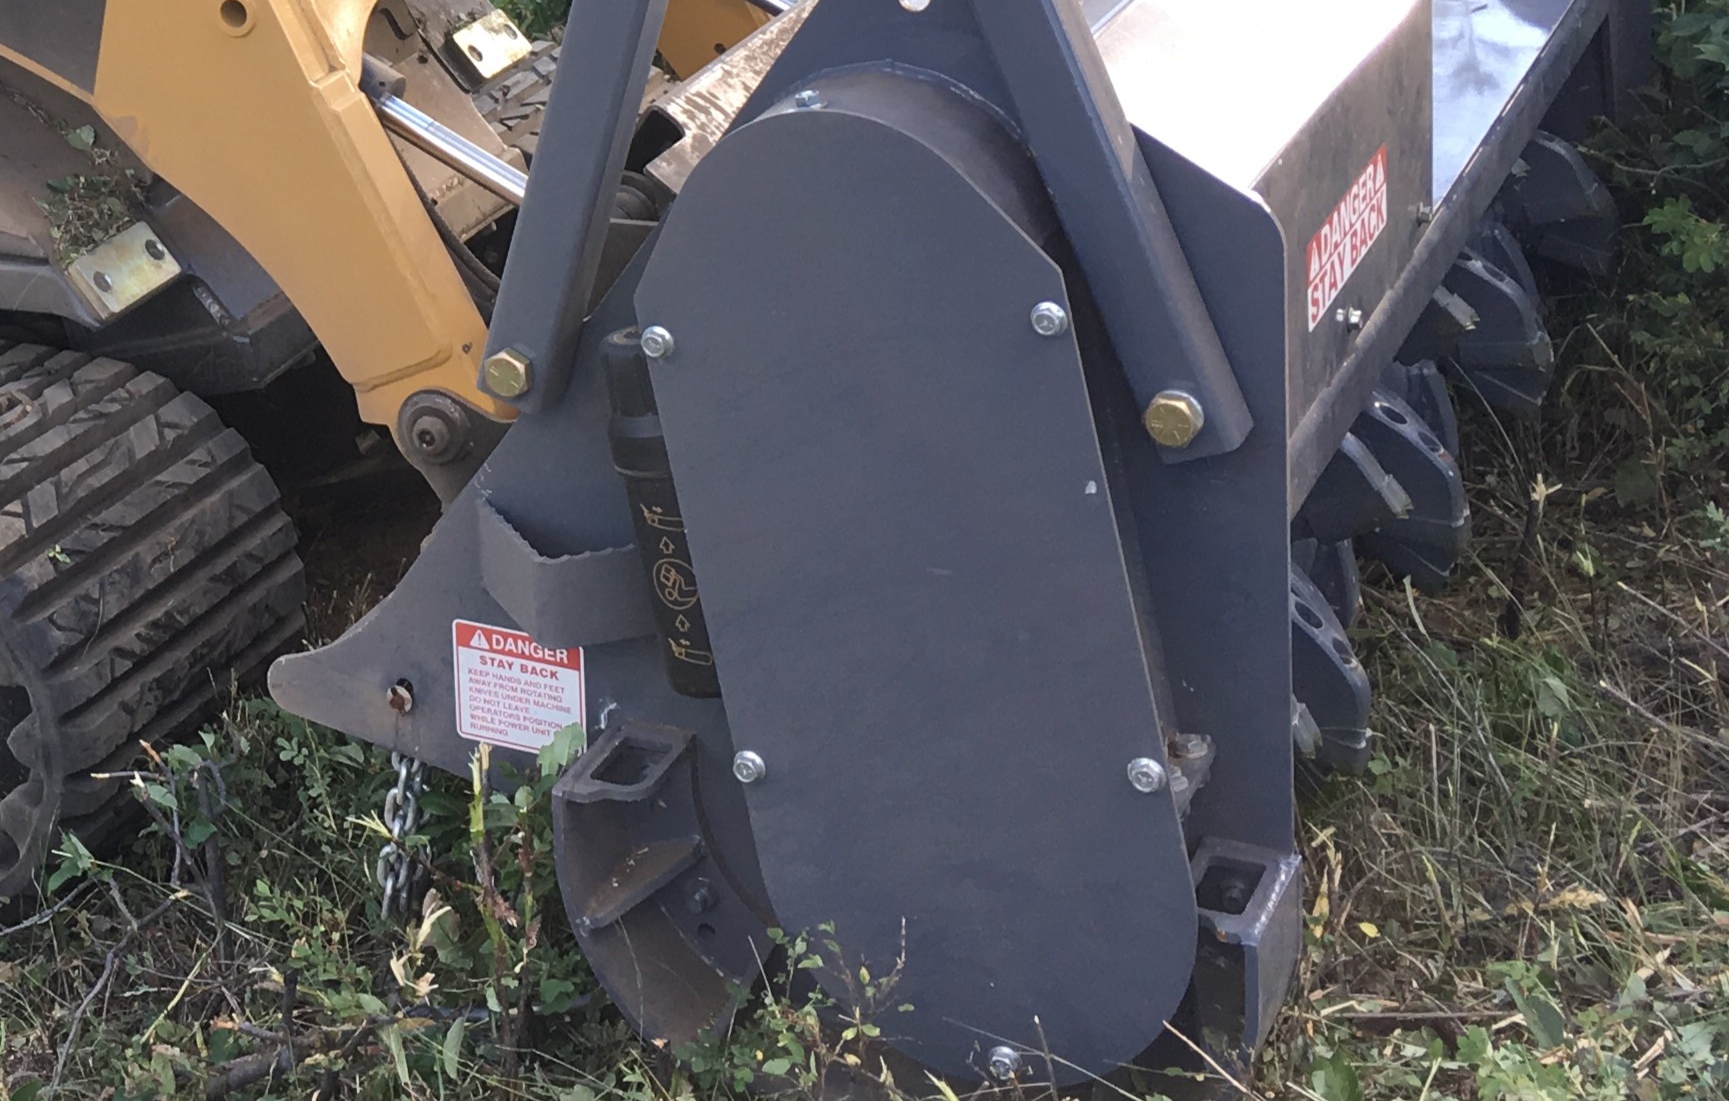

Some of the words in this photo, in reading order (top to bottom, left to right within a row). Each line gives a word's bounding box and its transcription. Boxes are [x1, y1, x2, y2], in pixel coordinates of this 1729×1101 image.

[1320, 162, 1376, 265] DANGER
[1311, 246, 1346, 325] STAY
[1349, 190, 1387, 269] BACK
[492, 634, 568, 664] DANGER
[467, 667, 490, 677] KEEP
[492, 671, 522, 685] HANDS
[523, 679, 542, 690] AND
[544, 683, 565, 695] FEET
[479, 655, 514, 671] STAY
[520, 664, 560, 681] BACK
[468, 677, 491, 687] AWAY
[493, 681, 518, 693] FROM
[520, 687, 563, 703] ROTATING
[469, 686, 499, 698] KNIVES
[501, 691, 531, 705] UNDER
[533, 699, 571, 714] MACHINE
[469, 694, 481, 704] DO
[483, 698, 500, 707] NOT
[503, 701, 530, 714] LEAVE
[469, 704, 521, 721] OPERATORS
[523, 715, 563, 730] POSITION
[470, 713, 497, 725] WHILE
[498, 718, 530, 732] POWER
[532, 726, 551, 737] UNIT
